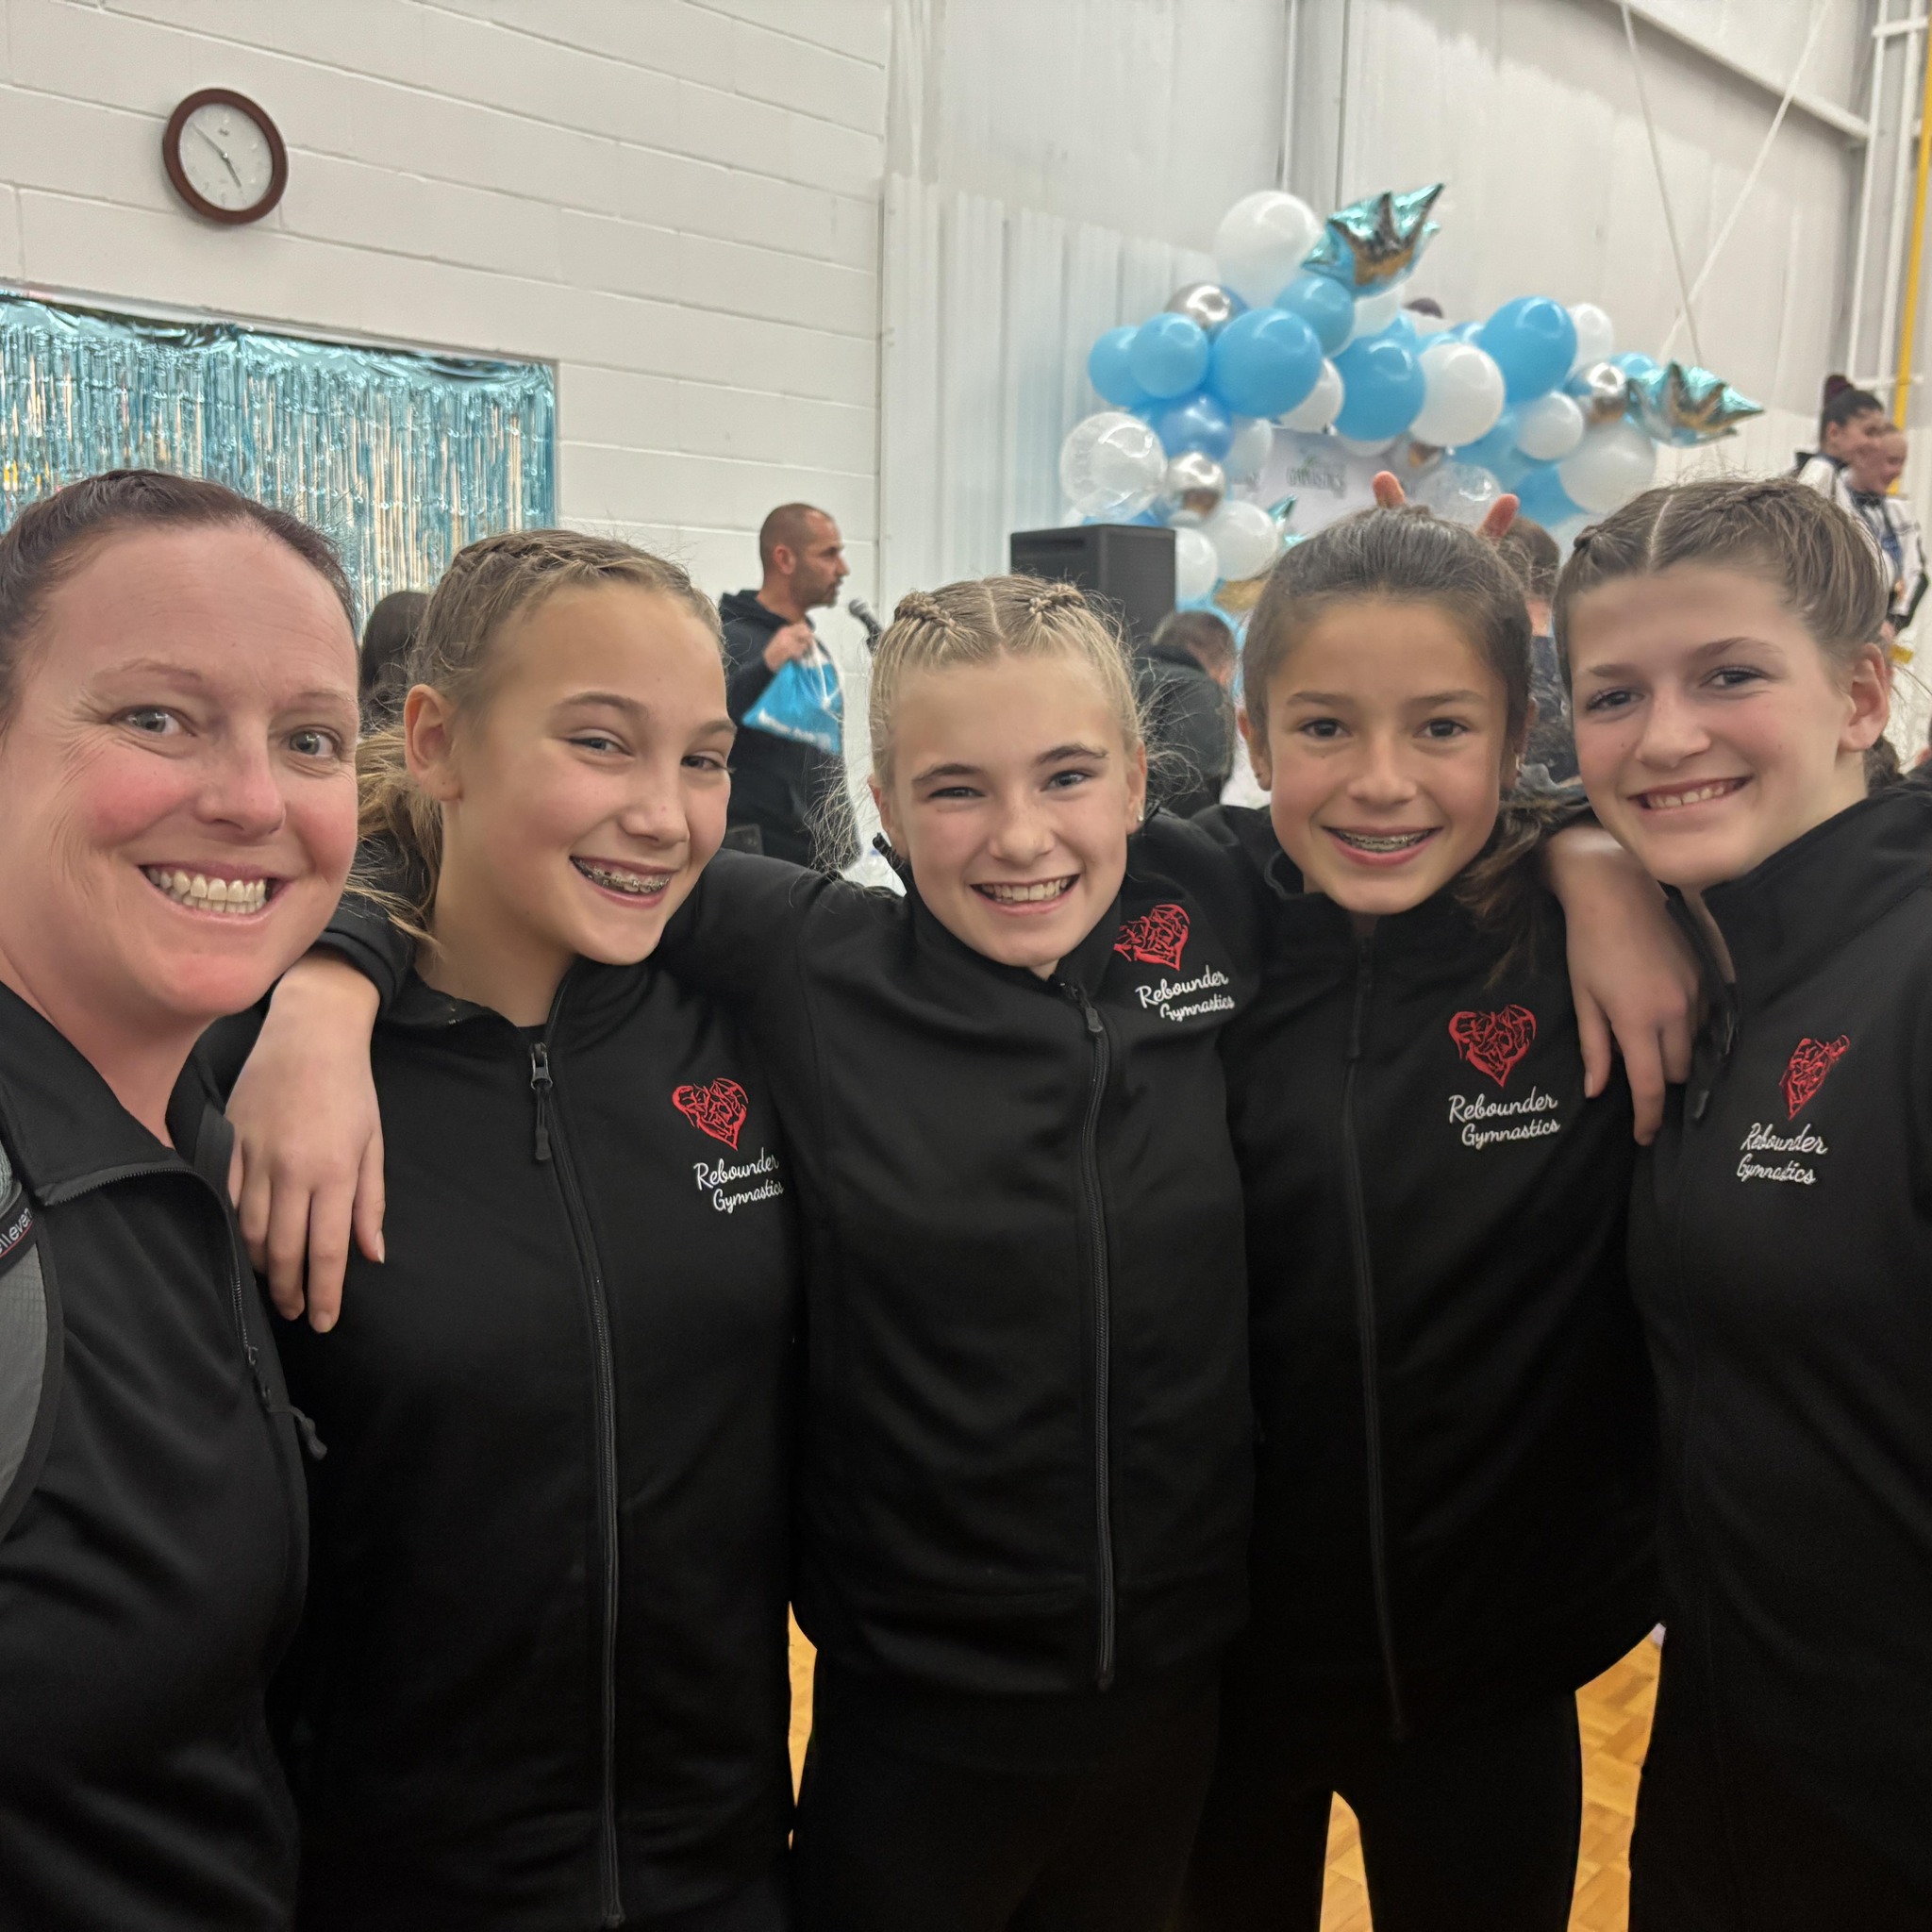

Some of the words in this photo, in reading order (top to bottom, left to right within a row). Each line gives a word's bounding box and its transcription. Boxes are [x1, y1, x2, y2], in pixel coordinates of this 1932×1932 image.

[1135, 964, 1229, 1008] Rebounder
[1159, 992, 1236, 1023] Gymnastics
[1448, 1085, 1558, 1124] Rebounder
[1461, 1118, 1561, 1150] Gymnastics
[1740, 1122, 1829, 1155] Rebounder
[692, 1146, 779, 1191] Rebounder
[1736, 1152, 1817, 1185] Gymnastics
[712, 1178, 784, 1214] Gymnastics
